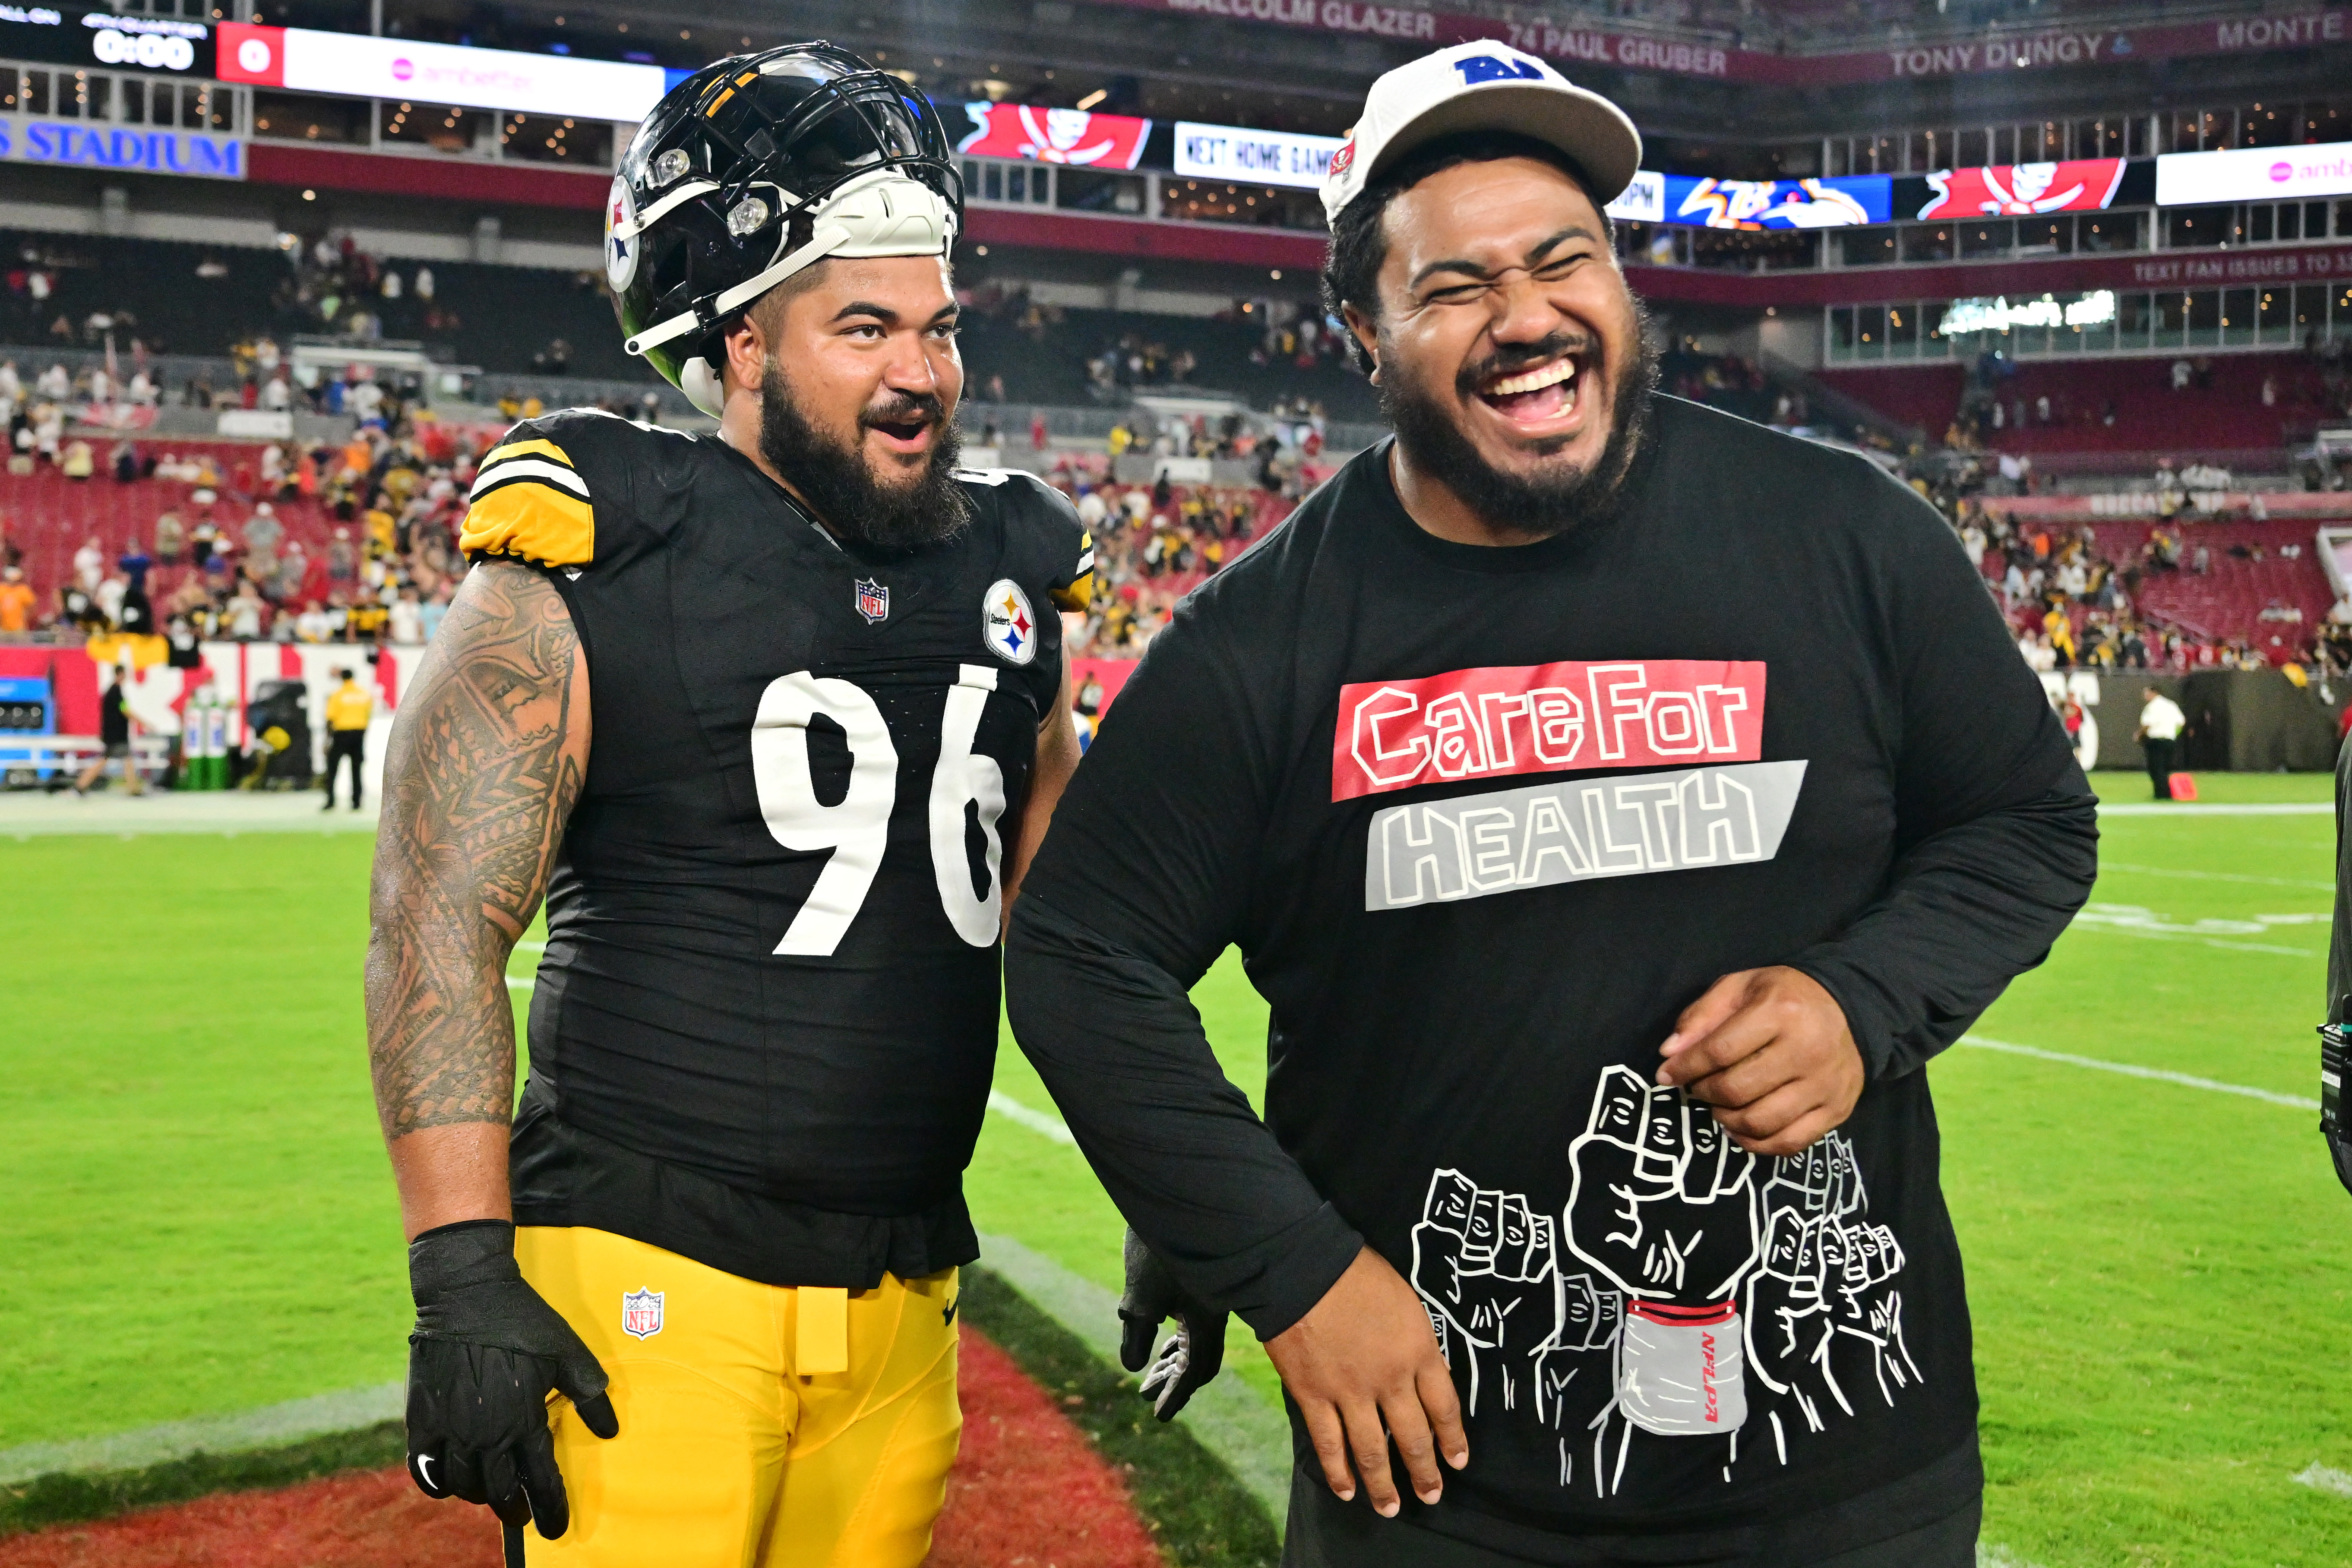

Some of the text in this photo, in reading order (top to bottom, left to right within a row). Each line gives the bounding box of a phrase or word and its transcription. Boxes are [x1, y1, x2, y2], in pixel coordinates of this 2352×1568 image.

[1321, 2, 1435, 39] GLAZER
[2217, 13, 2344, 49] MONTE
[93, 28, 194, 70] 0:00
[238, 39, 271, 73] 0
[1509, 23, 1728, 75] 74 PAUL GRUBER
[1890, 34, 2104, 78] TONY DUNGY
[26, 122, 242, 176] STADIUM
[1185, 136, 1227, 165] NEXT
[1236, 141, 1281, 172] HOME
[2306, 252, 2331, 272] TO
[862, 595, 883, 615] NFL
[990, 613, 1010, 626] Steelers
[1351, 664, 1748, 786] Care For
[751, 663, 1006, 956] 96
[1382, 770, 1761, 905] HEALTH
[629, 1311, 657, 1331] NFL
[1701, 1331, 1718, 1423] NFLPA
